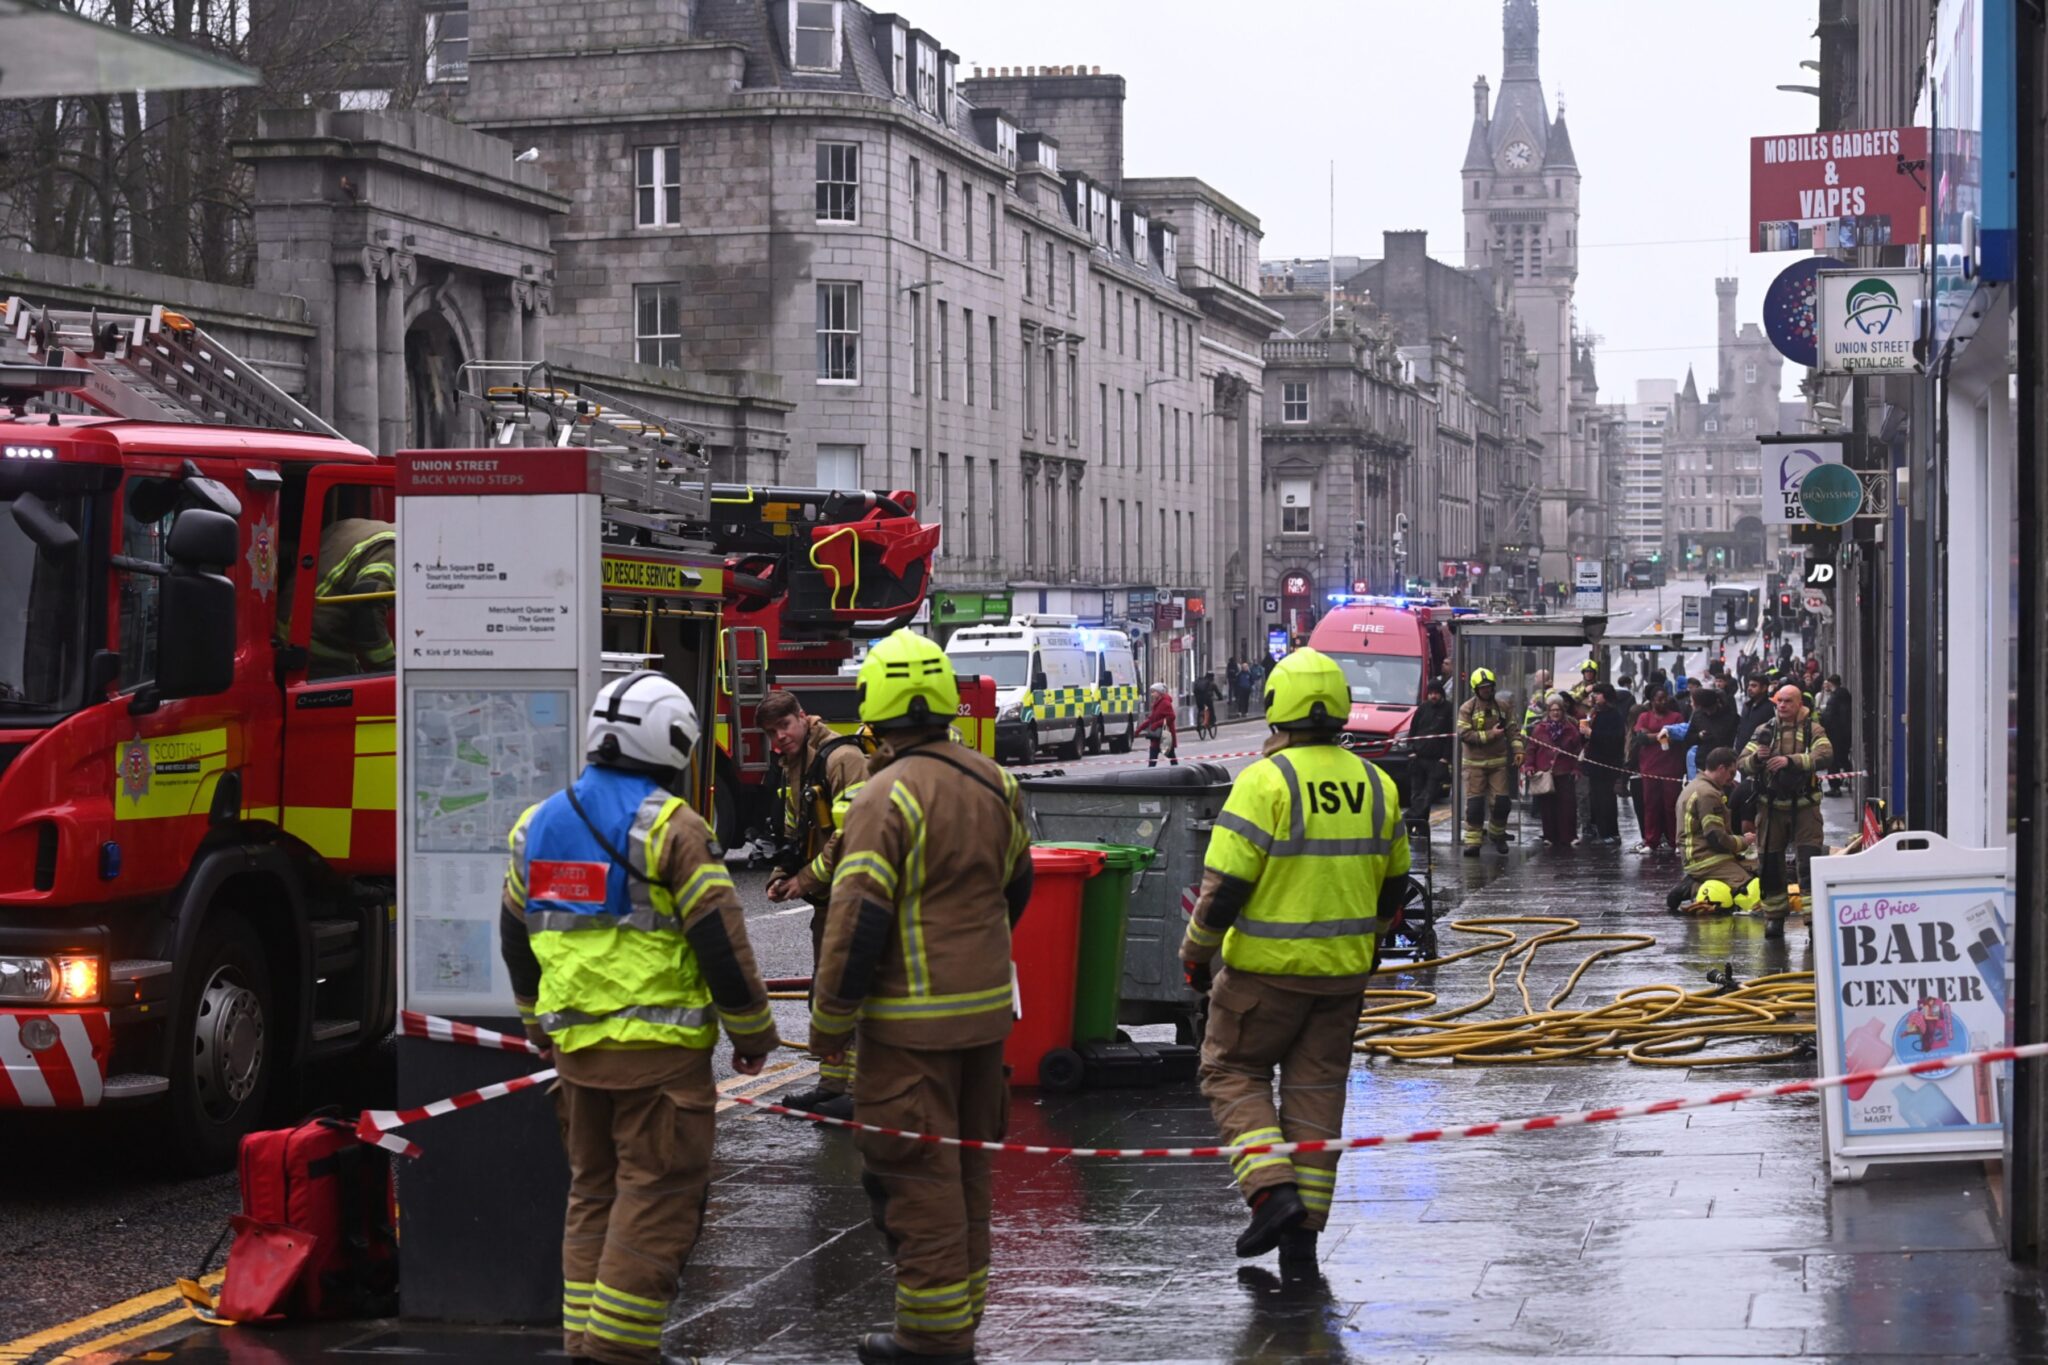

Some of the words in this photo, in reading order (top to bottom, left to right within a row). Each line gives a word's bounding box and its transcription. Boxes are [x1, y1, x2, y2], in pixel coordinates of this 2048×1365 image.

[1764, 134, 1828, 164] MOBILES
[1832, 130, 1899, 159] GADGETS
[1824, 161, 1839, 185] &
[1799, 186, 1866, 219] VAPES
[1835, 342, 1867, 354] UNION
[1871, 341, 1910, 354] STREET
[1843, 357, 1876, 369] DENTAL
[1880, 356, 1905, 368] CARE
[412, 460, 451, 471] UNION
[456, 460, 498, 471] STREET
[412, 475, 443, 485] BACK
[448, 475, 484, 485] WYND
[488, 475, 524, 485] STEPS
[1781, 491, 1800, 504] TA
[1802, 489, 1859, 500] BRAVISSIMO
[1784, 506, 1806, 519] BE
[426, 563, 447, 571] Union
[450, 563, 475, 572] Square
[1807, 563, 1833, 582] JD
[426, 572, 450, 580] Tourist
[453, 572, 497, 580] Information
[601, 561, 613, 583] ND
[614, 562, 644, 585] RESCUE
[646, 565, 676, 588] SERVICE
[426, 582, 465, 591] Castlegate
[488, 606, 524, 614] Merchant
[526, 606, 555, 614] Quarter
[505, 624, 527, 632] Union
[529, 624, 555, 633] Square
[1352, 623, 1385, 633] FIRE
[443, 648, 451, 656] of
[453, 648, 461, 656] St
[462, 648, 494, 656] Nicholas
[155, 742, 201, 760] SCOTTISH
[1306, 781, 1366, 814] ISV
[551, 866, 587, 880] SAFETY
[549, 883, 590, 897] OFFICER
[1839, 902, 1872, 925] Cut
[1874, 899, 1920, 920] Price
[1839, 922, 1961, 966] BAR
[1841, 976, 1985, 1007] CENTER
[1864, 1105, 1892, 1114] LOST
[1864, 1114, 1893, 1123] MARY
